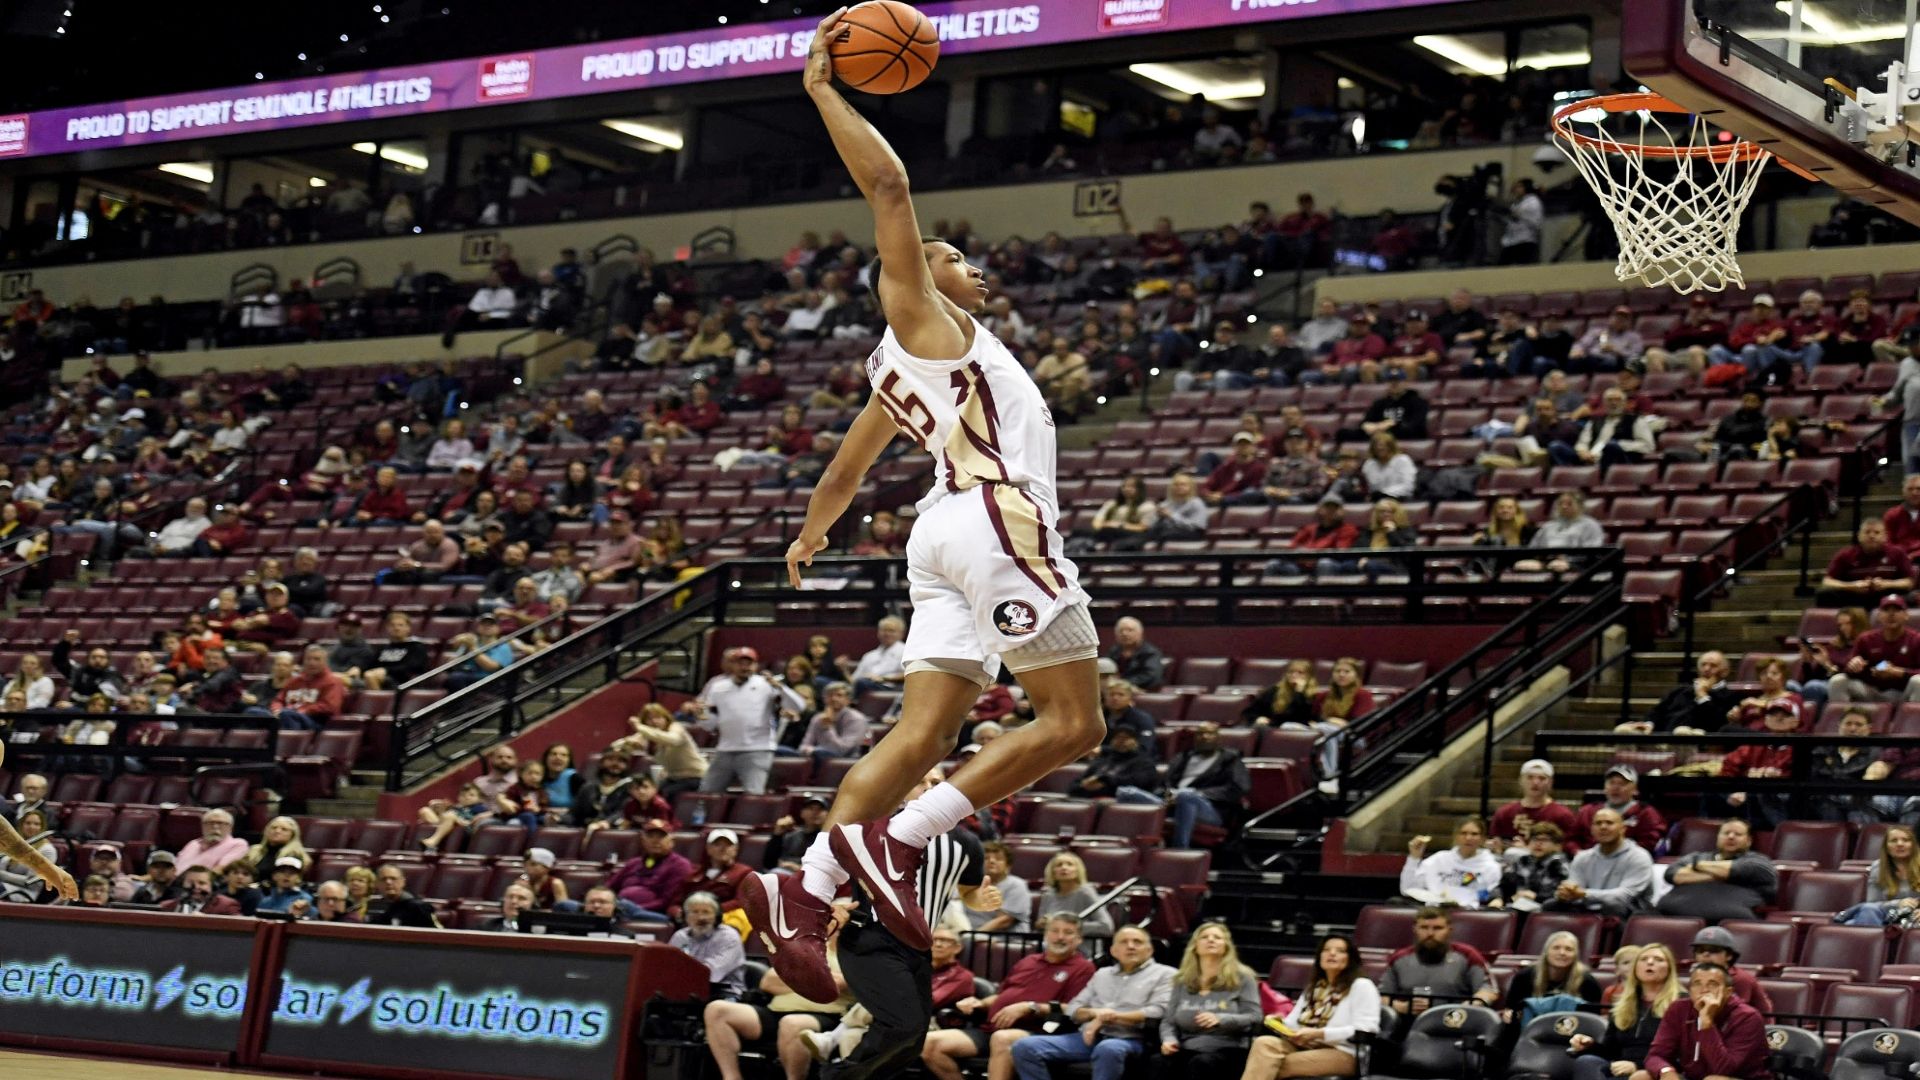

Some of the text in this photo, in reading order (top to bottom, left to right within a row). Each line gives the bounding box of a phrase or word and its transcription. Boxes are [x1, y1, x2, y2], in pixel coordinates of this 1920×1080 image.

[581, 49, 655, 81] PROUD
[656, 45, 686, 72] TO
[687, 33, 790, 69] SUPPORT
[925, 5, 1040, 41] THLETICS
[66, 77, 432, 141] PROUD TO SUPPORT SEMINOLE ATHLETICS
[0, 961, 146, 1002] erform
[377, 989, 604, 1038] solutions
